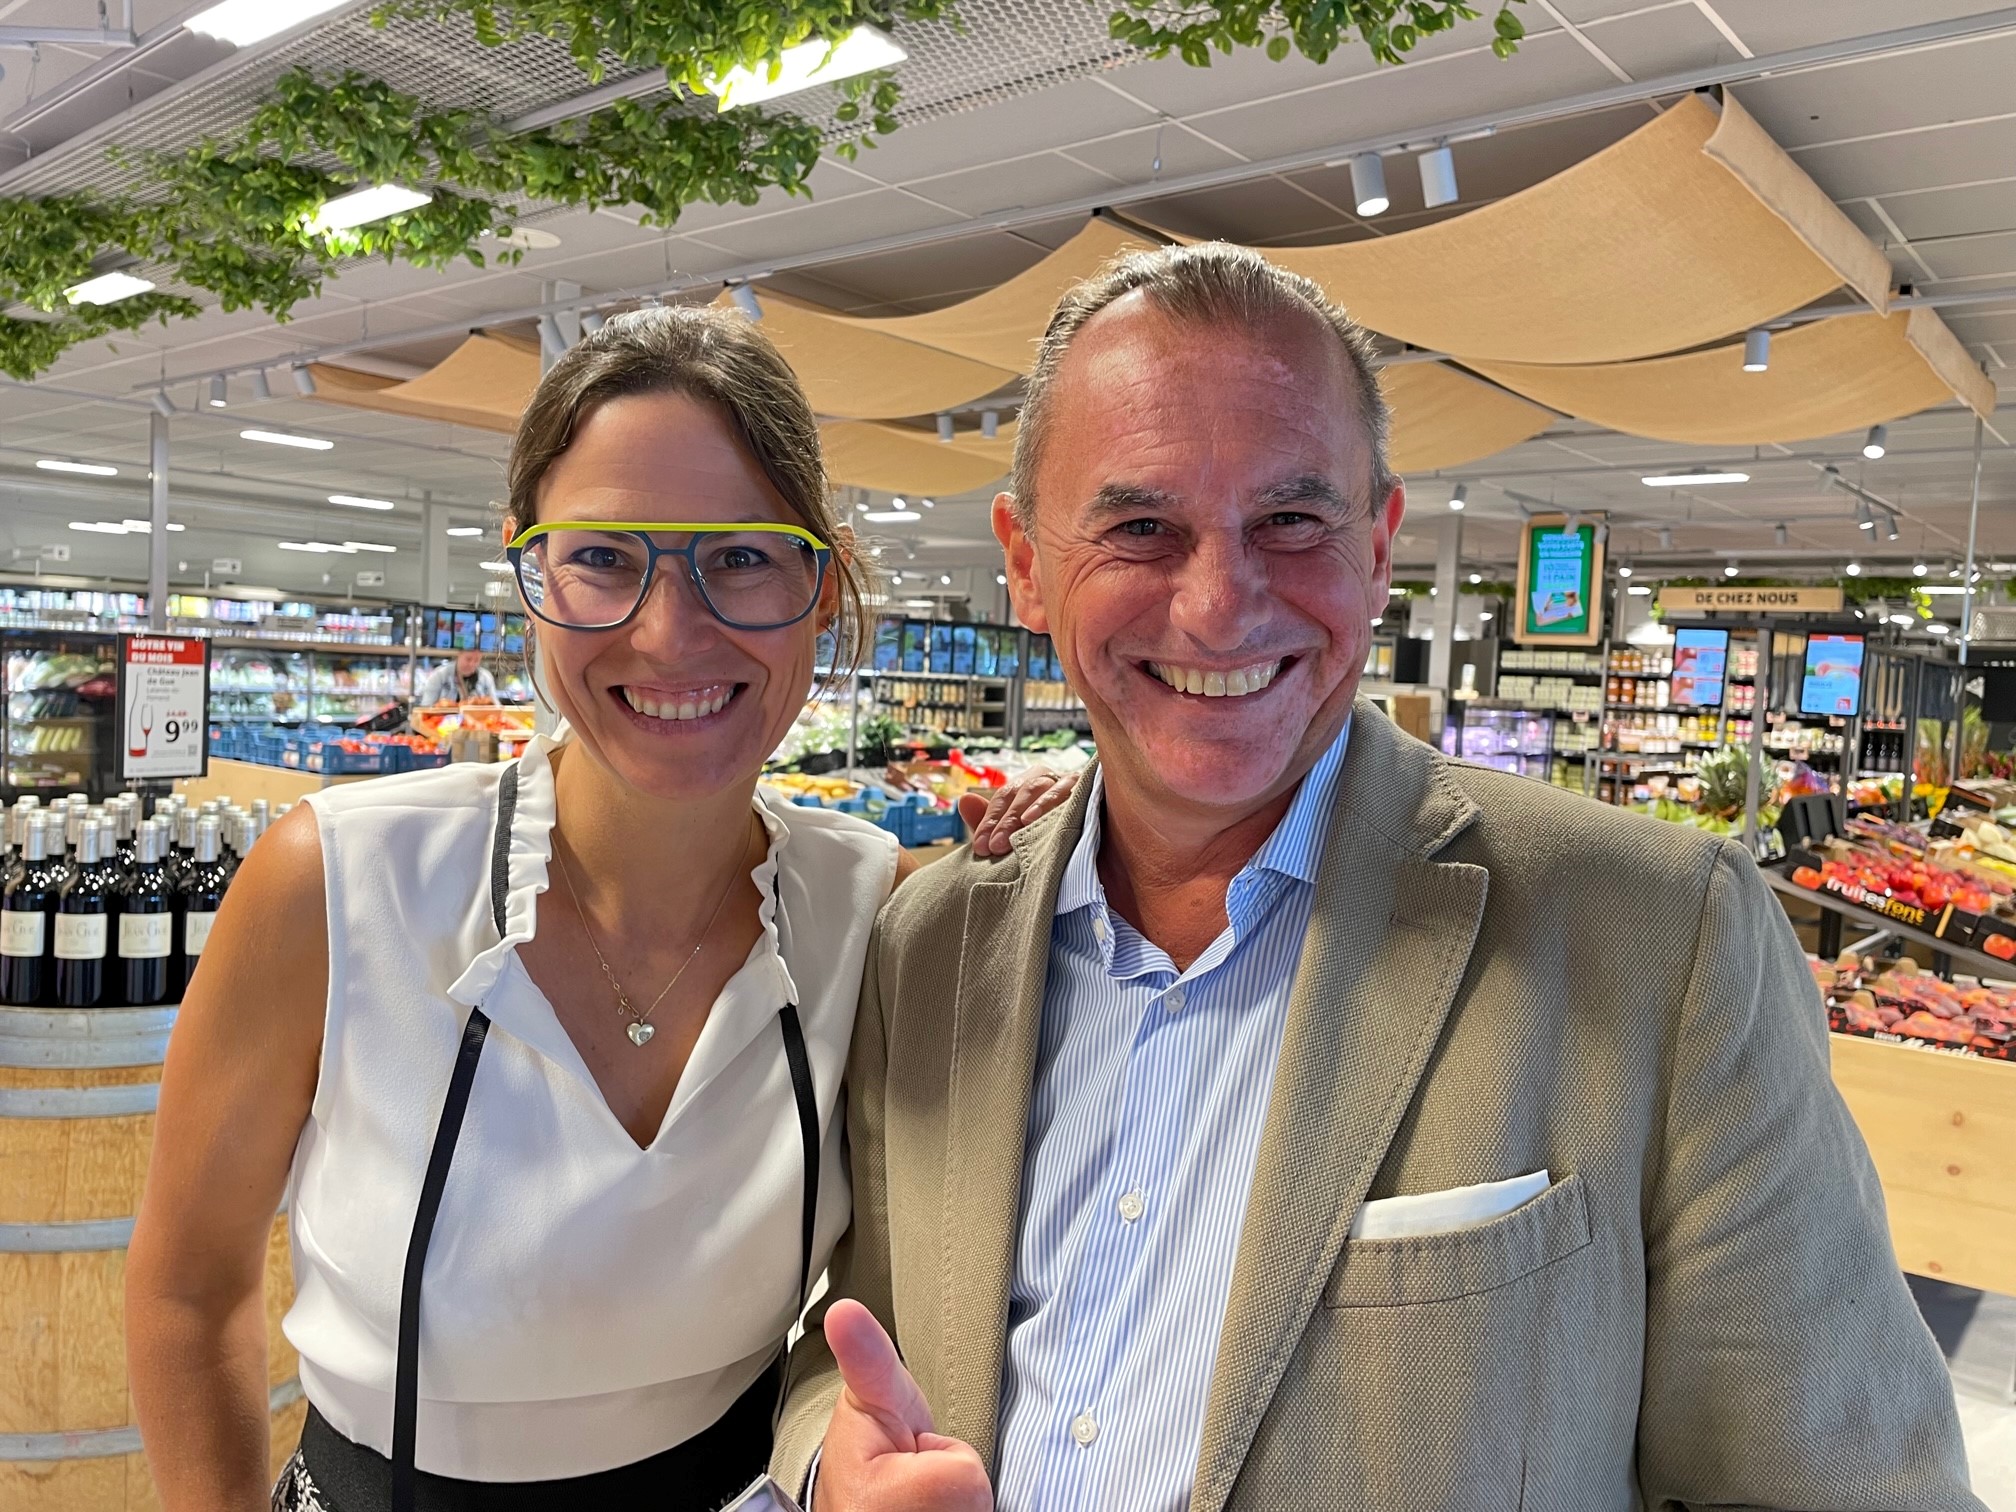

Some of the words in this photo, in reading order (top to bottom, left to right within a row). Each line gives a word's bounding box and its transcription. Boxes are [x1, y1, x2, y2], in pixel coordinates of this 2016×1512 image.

[1695, 591, 1713, 604] DE
[1717, 591, 1753, 604] CHEZ
[1757, 591, 1798, 604] NOUS
[131, 638, 166, 651] NOTRE
[167, 640, 185, 652] VIN
[131, 651, 147, 663] DU
[147, 652, 174, 664] MOIS
